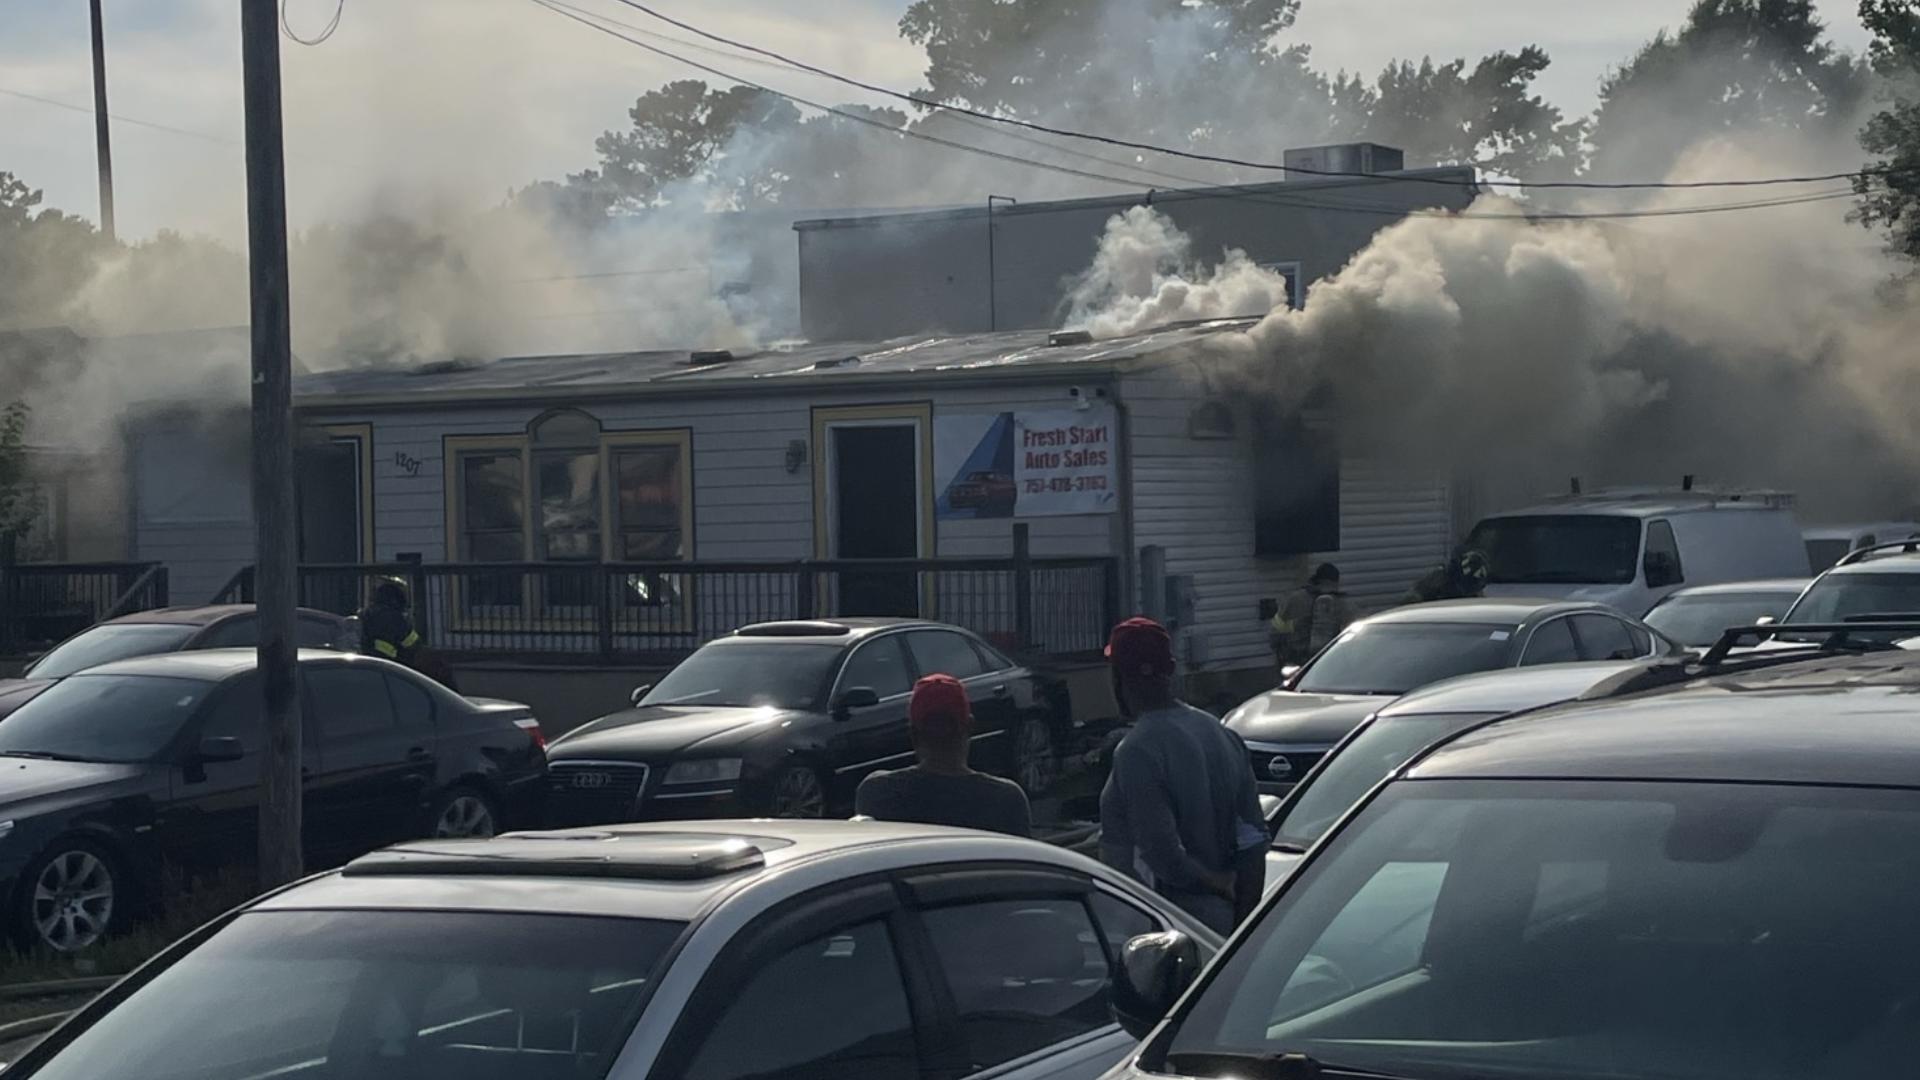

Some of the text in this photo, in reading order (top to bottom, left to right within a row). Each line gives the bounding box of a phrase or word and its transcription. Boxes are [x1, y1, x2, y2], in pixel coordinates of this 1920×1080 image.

[1023, 425, 1108, 447] Fresh Start
[395, 451, 423, 478] 1207
[1025, 448, 1108, 470] Auto Sales
